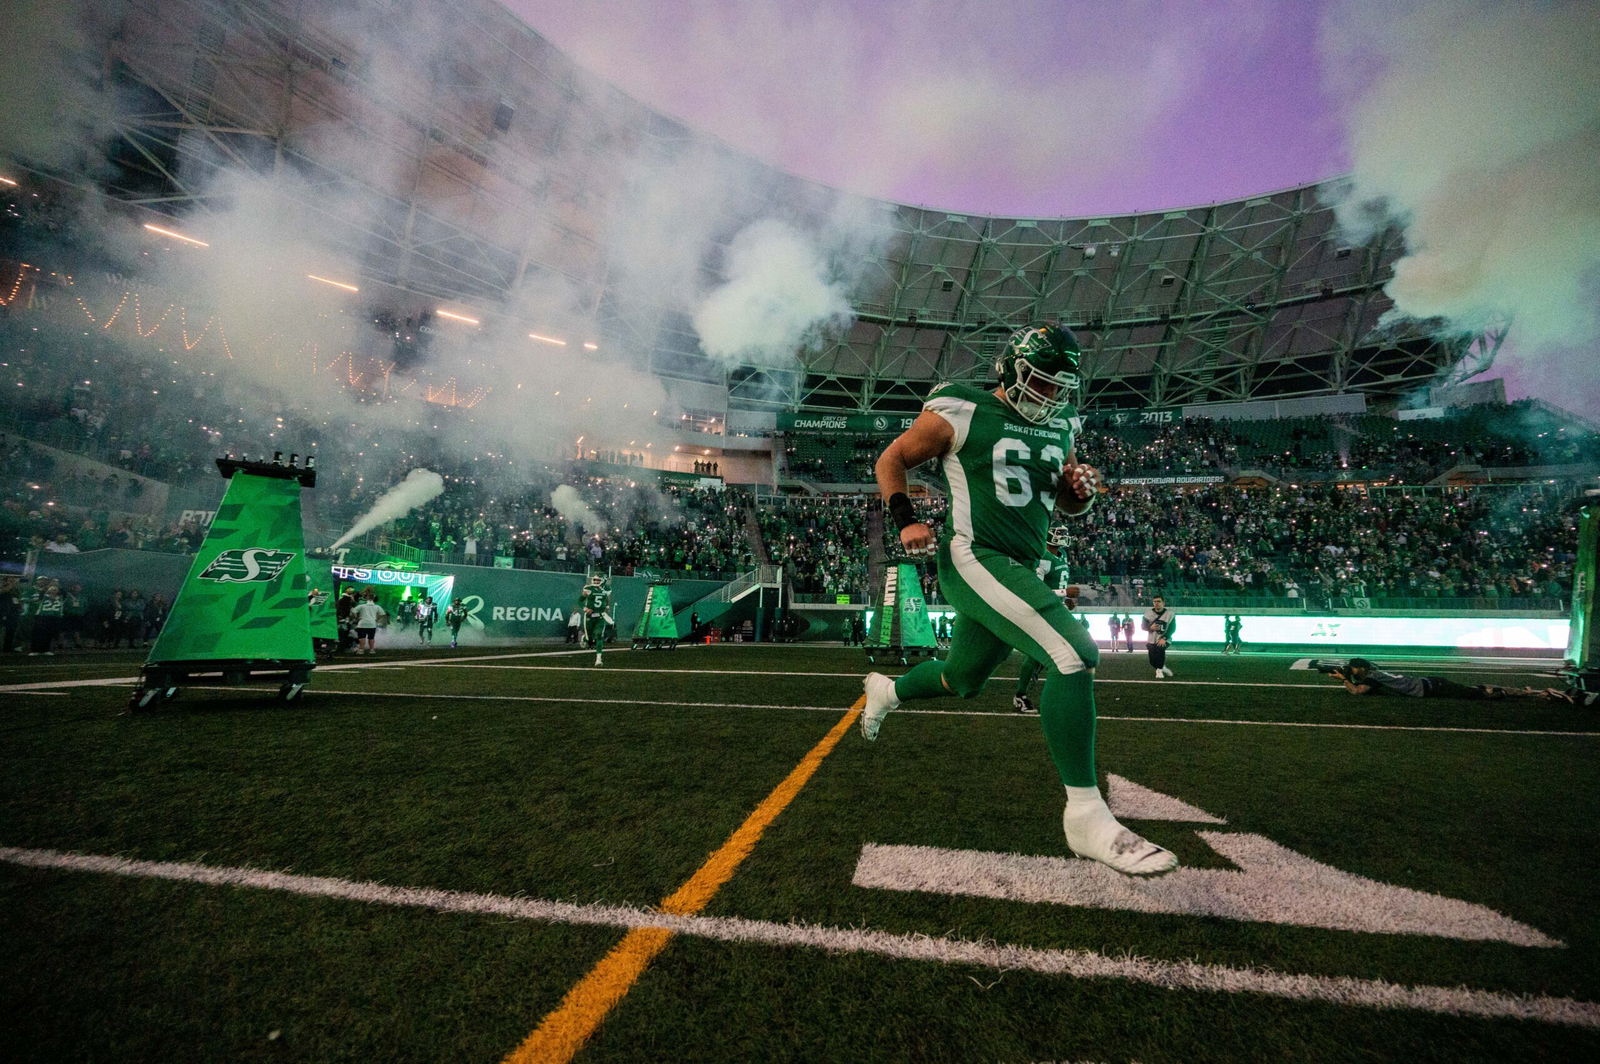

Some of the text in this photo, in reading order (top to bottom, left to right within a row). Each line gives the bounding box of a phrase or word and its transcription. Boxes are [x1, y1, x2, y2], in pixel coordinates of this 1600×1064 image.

[794, 419, 847, 429] CHAMPIONS
[1004, 422, 1061, 440] SASKATCHEWAN
[1120, 475, 1225, 485] SASKATCHEWAN ROUGHRIDERS
[42, 600, 62, 612] 22
[593, 596, 603, 608] 5
[492, 606, 563, 621] REGINA
